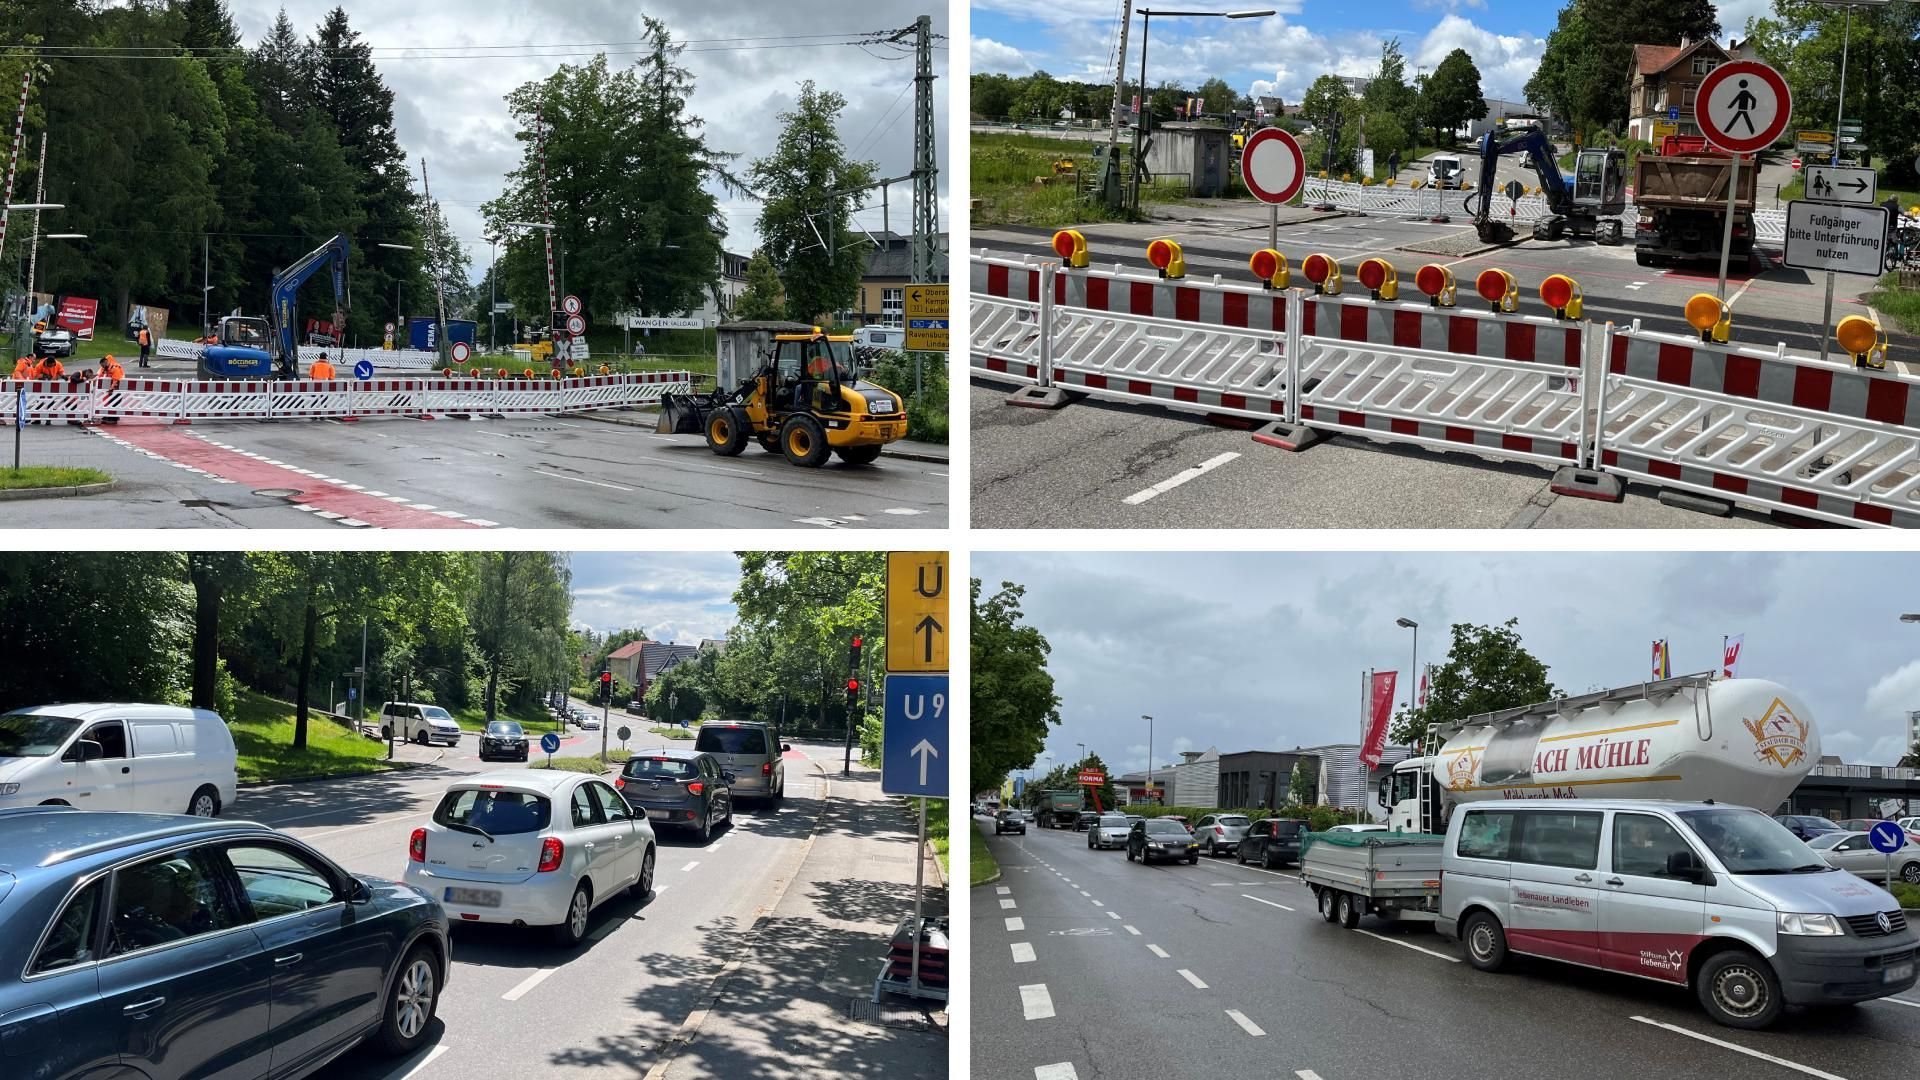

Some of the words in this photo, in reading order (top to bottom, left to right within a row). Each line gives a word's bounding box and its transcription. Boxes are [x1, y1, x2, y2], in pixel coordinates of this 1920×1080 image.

[1809, 214, 1861, 231] Fußgänger
[1789, 228, 1811, 240] bitte
[1814, 230, 1879, 250] Unterführung
[1816, 248, 1848, 260] nutzen
[634, 319, 668, 327] WANGEN
[427, 323, 436, 347] PEMA
[919, 566, 942, 598] U
[1575, 738, 1651, 770] MÜHLE
[1552, 895, 1590, 908] Landleben
[1640, 950, 1667, 962] Stiftung
[1640, 957, 1670, 969] Liebenau
